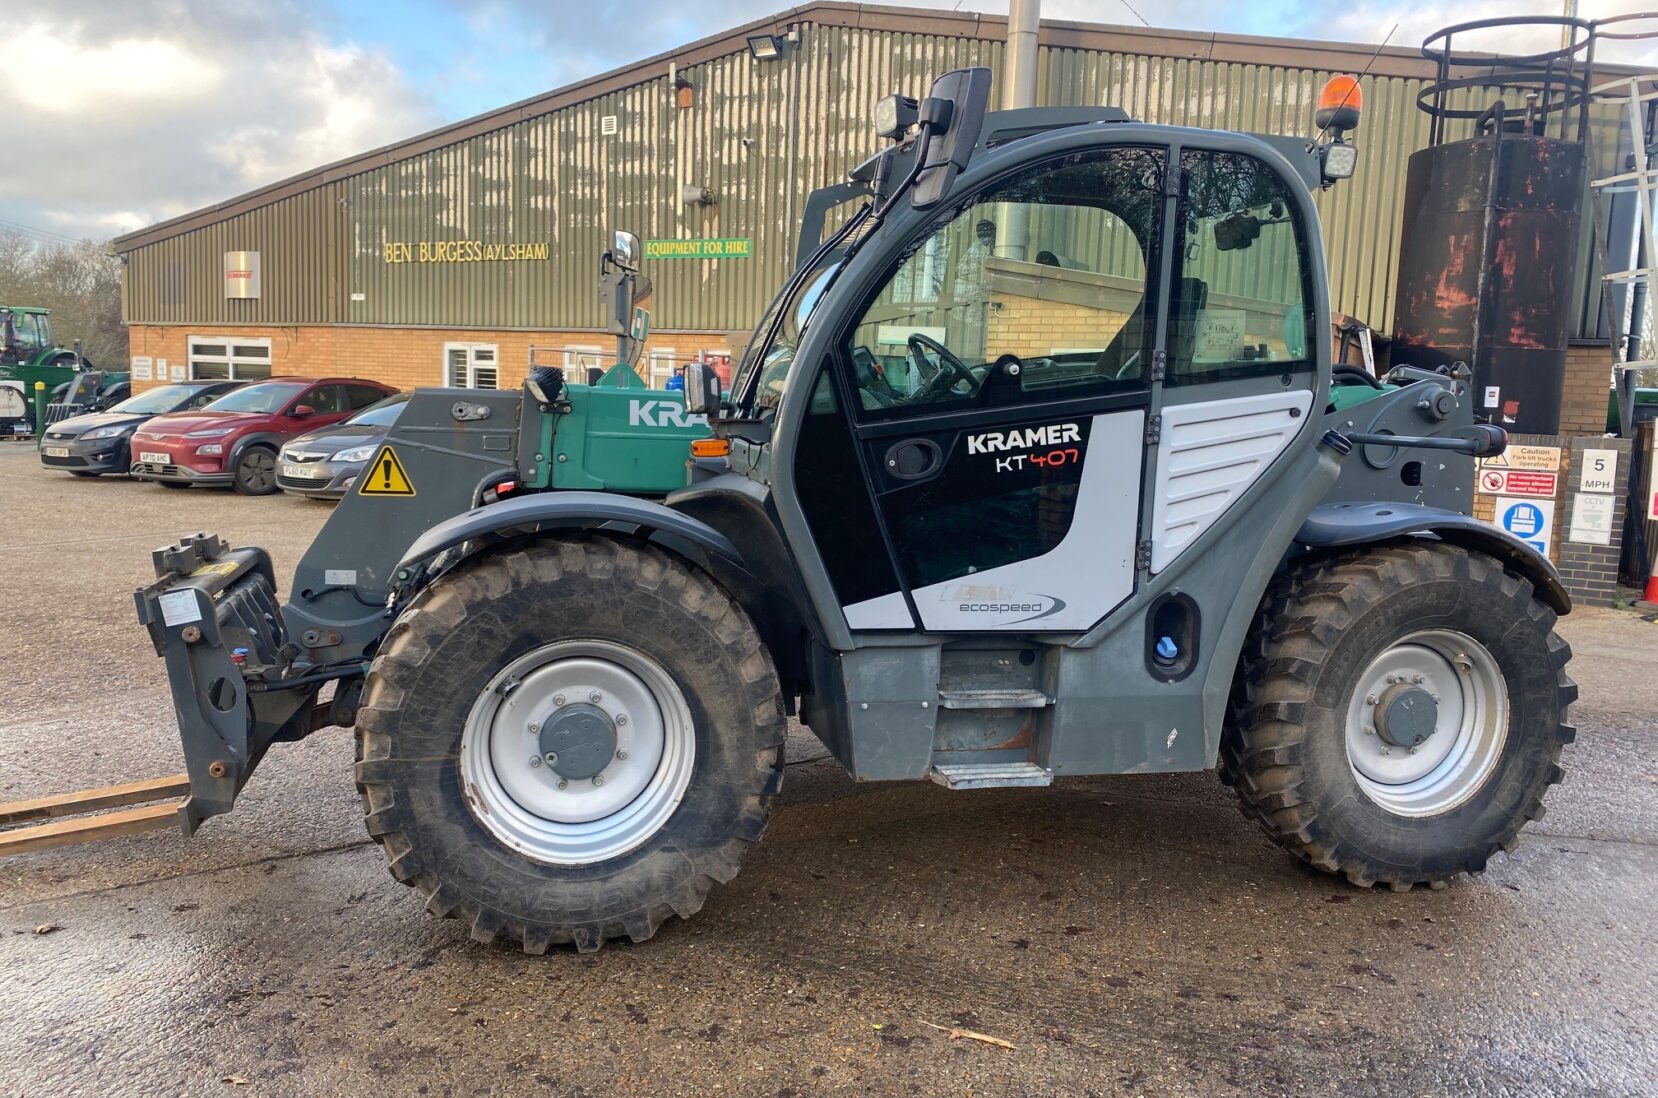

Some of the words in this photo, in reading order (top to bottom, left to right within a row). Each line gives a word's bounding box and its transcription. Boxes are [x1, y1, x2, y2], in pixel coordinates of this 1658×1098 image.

[385, 242, 412, 263] BEN
[419, 240, 482, 262] BURGESS
[647, 241, 701, 256] EQUIPMENT
[703, 241, 723, 254] FOR
[725, 241, 748, 254] HIRE
[967, 423, 1082, 455] KRAMER
[1520, 447, 1550, 455] Caution
[1594, 459, 1605, 472] 5
[1584, 480, 1610, 489] MPH
[1584, 497, 1605, 505] CCTV
[959, 602, 1042, 614] ecospeed
